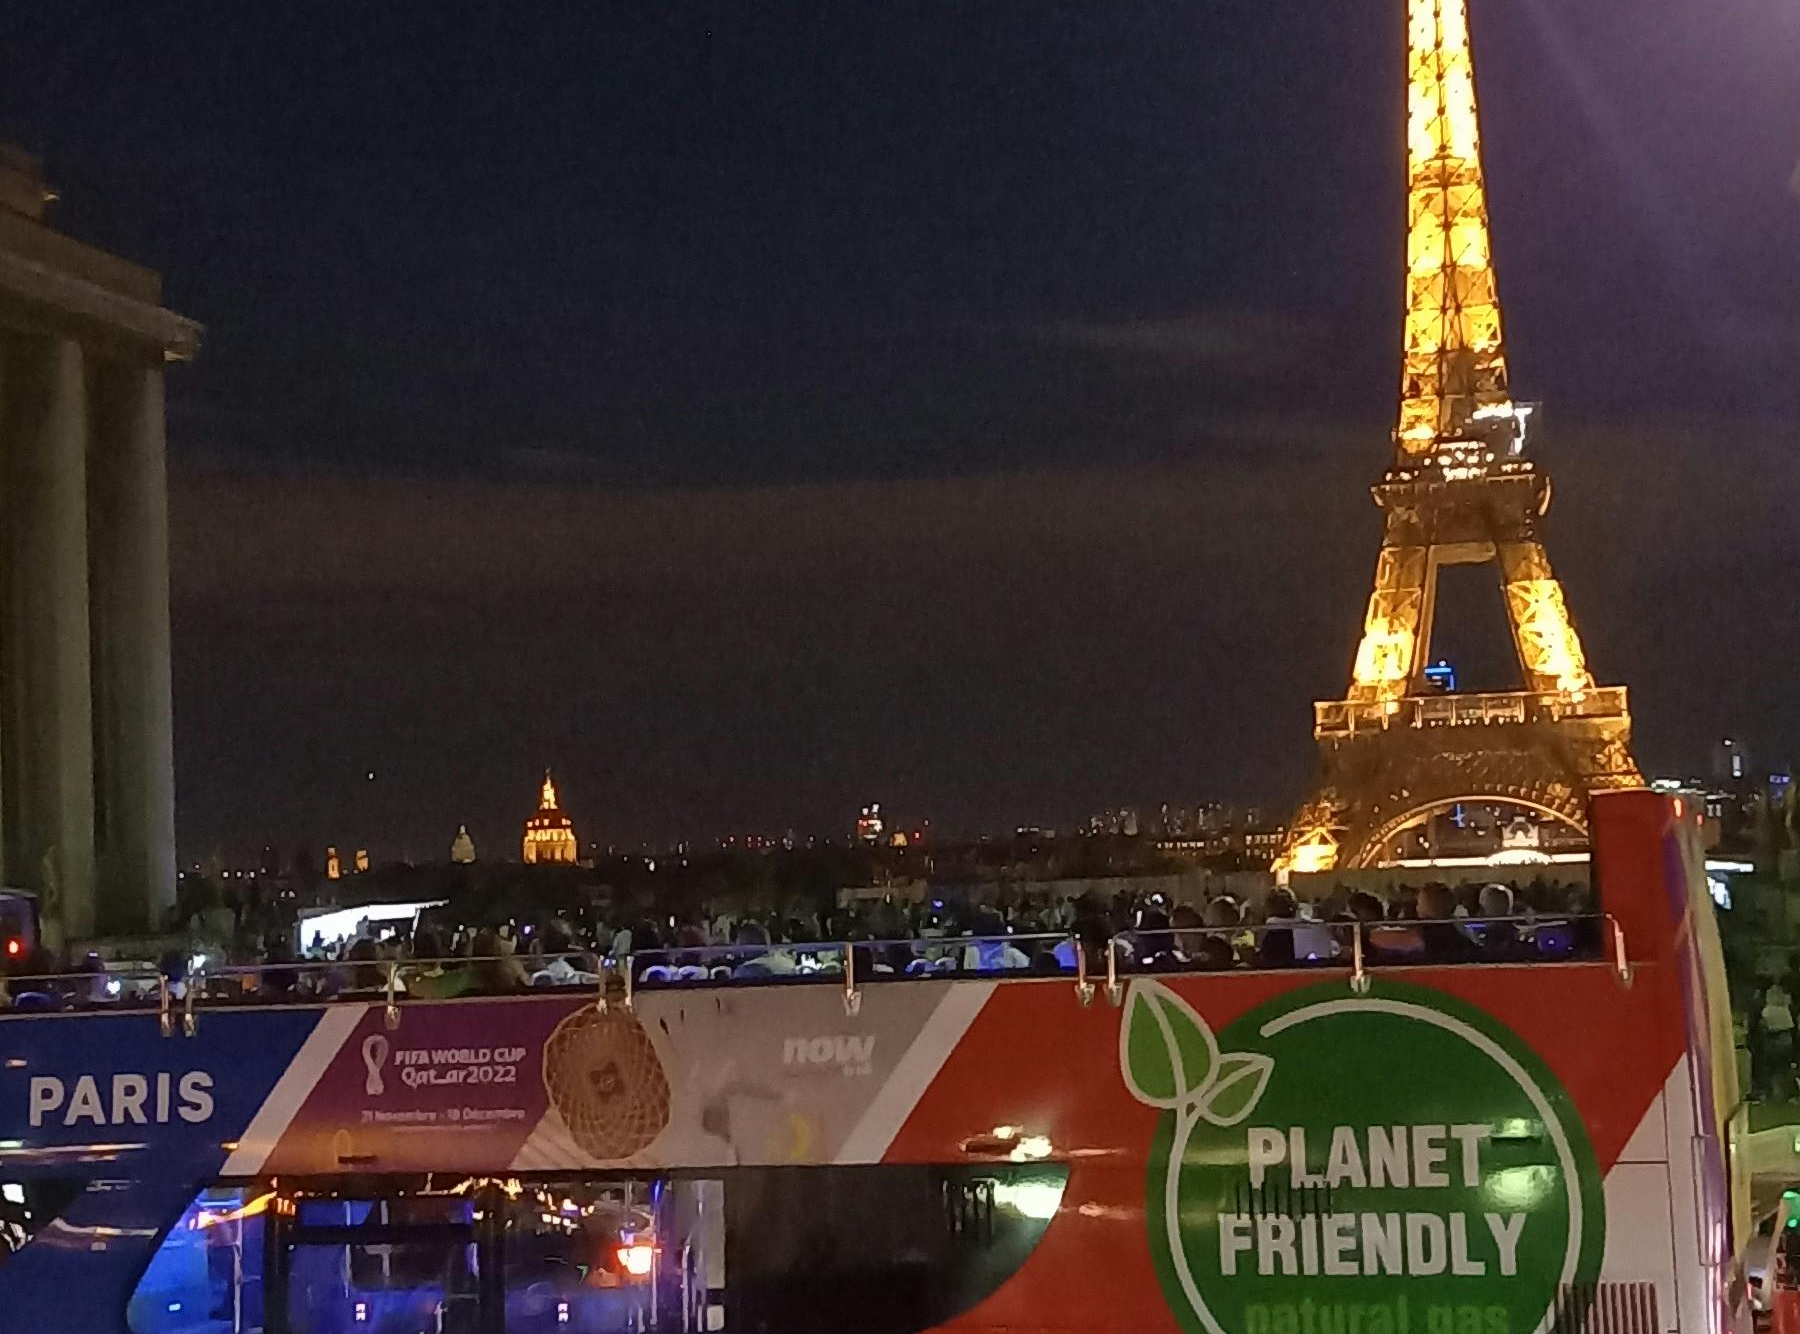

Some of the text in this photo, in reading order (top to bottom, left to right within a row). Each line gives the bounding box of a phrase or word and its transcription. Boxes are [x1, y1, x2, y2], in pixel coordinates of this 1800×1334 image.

[394, 1047, 527, 1066] FIFA WORLD CUP
[783, 1035, 875, 1064] now
[29, 1070, 214, 1127] PARIS
[1247, 1124, 1493, 1189] PLANET
[1217, 1212, 1527, 1276] FRIENDLY
